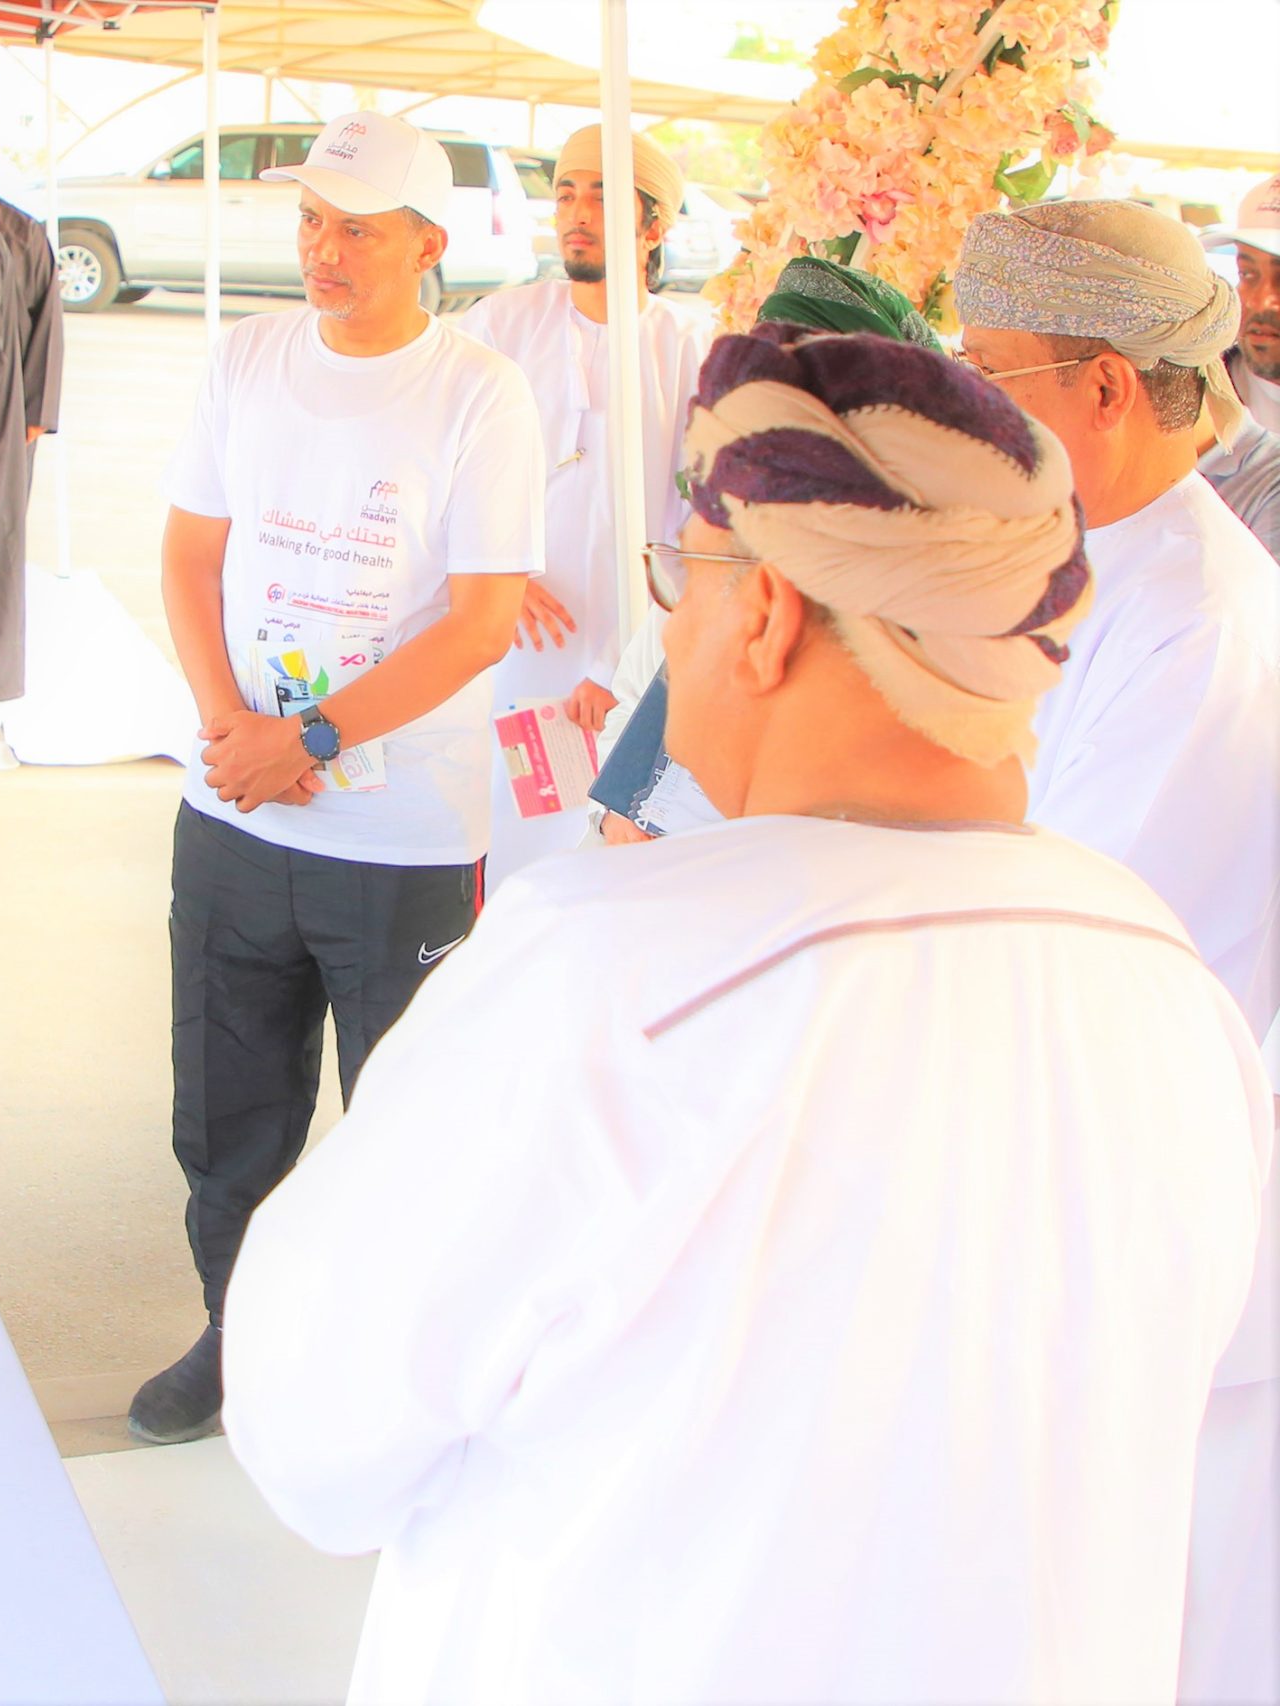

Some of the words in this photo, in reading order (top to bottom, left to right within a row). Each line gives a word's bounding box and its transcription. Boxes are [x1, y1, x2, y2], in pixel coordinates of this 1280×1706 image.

[262, 509, 317, 533] ممشاك
[360, 511, 397, 524] madayn
[320, 523, 342, 543] في
[346, 526, 396, 548] صحتك
[258, 531, 303, 555] Walking
[305, 541, 321, 556] for
[323, 547, 350, 561] good
[352, 551, 394, 569] health
